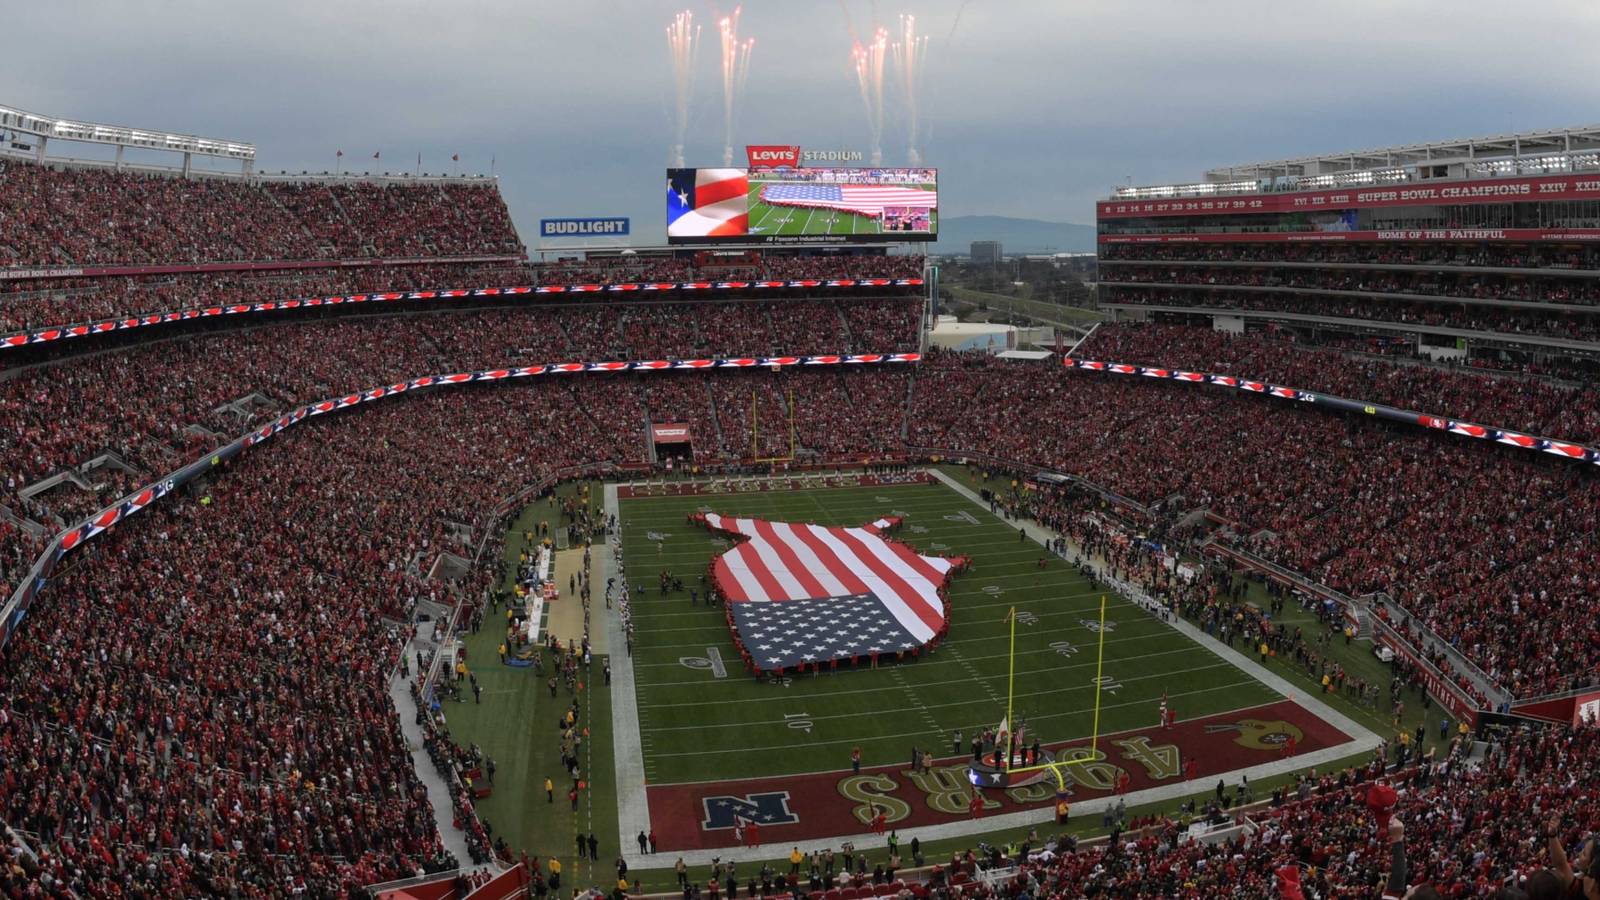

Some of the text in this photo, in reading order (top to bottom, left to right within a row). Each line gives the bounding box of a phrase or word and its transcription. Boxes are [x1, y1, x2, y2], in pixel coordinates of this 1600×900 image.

[803, 151, 862, 160] STADIUM
[1357, 191, 1397, 202] SUPER
[1401, 189, 1439, 200] BOWL
[1441, 184, 1531, 198] CHAMPIONS
[1539, 182, 1567, 193] XXIV
[1158, 203, 1169, 211] 27
[1186, 202, 1198, 210] 34
[1217, 201, 1229, 209] 37
[1249, 199, 1263, 208] 42
[1378, 230, 1506, 239] HOME OF THE FAITHFUL
[784, 712, 814, 729] 10
